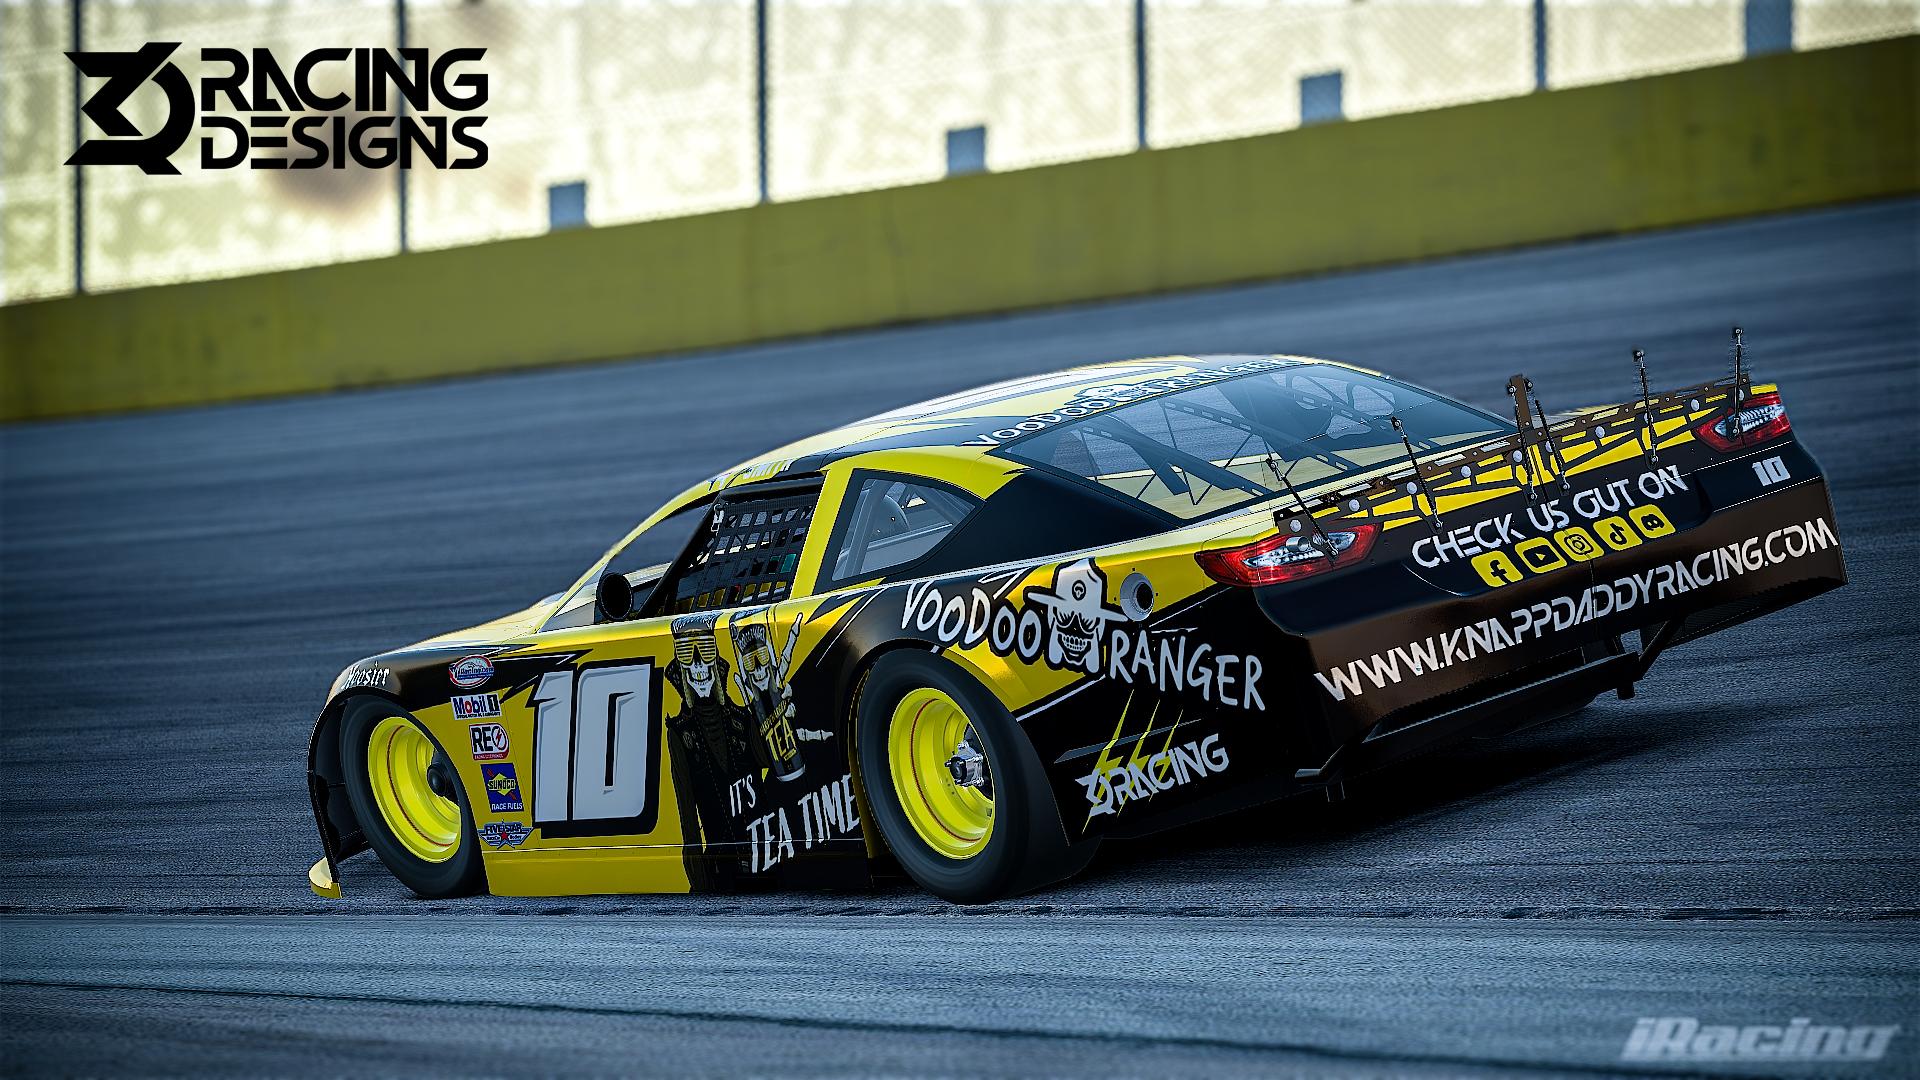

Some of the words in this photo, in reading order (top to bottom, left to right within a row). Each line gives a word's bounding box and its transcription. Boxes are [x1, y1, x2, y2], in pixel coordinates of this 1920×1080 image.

[960, 397, 1111, 447] VOODOO
[1751, 455, 1791, 487] 10
[1411, 512, 1526, 568] CHECK
[1526, 499, 1570, 532] US
[1573, 479, 1636, 519] OUT
[1638, 464, 1689, 499] ON
[1314, 517, 1839, 702] WWW.KNAPPDADDYRACING.COM
[901, 580, 1042, 657] VOODOO
[1109, 629, 1266, 711] RANGER
[341, 661, 391, 690] Hoosier
[453, 695, 487, 715] Mobil
[487, 694, 500, 711] 1
[531, 661, 654, 825] 10
[765, 714, 798, 762] TEA
[487, 779, 516, 790] SUNOCO
[1108, 733, 1230, 805] RACING
[491, 802, 507, 811] RACE
[729, 774, 757, 817] IT'S
[746, 807, 795, 874] TEA
[798, 773, 861, 850] TIME
